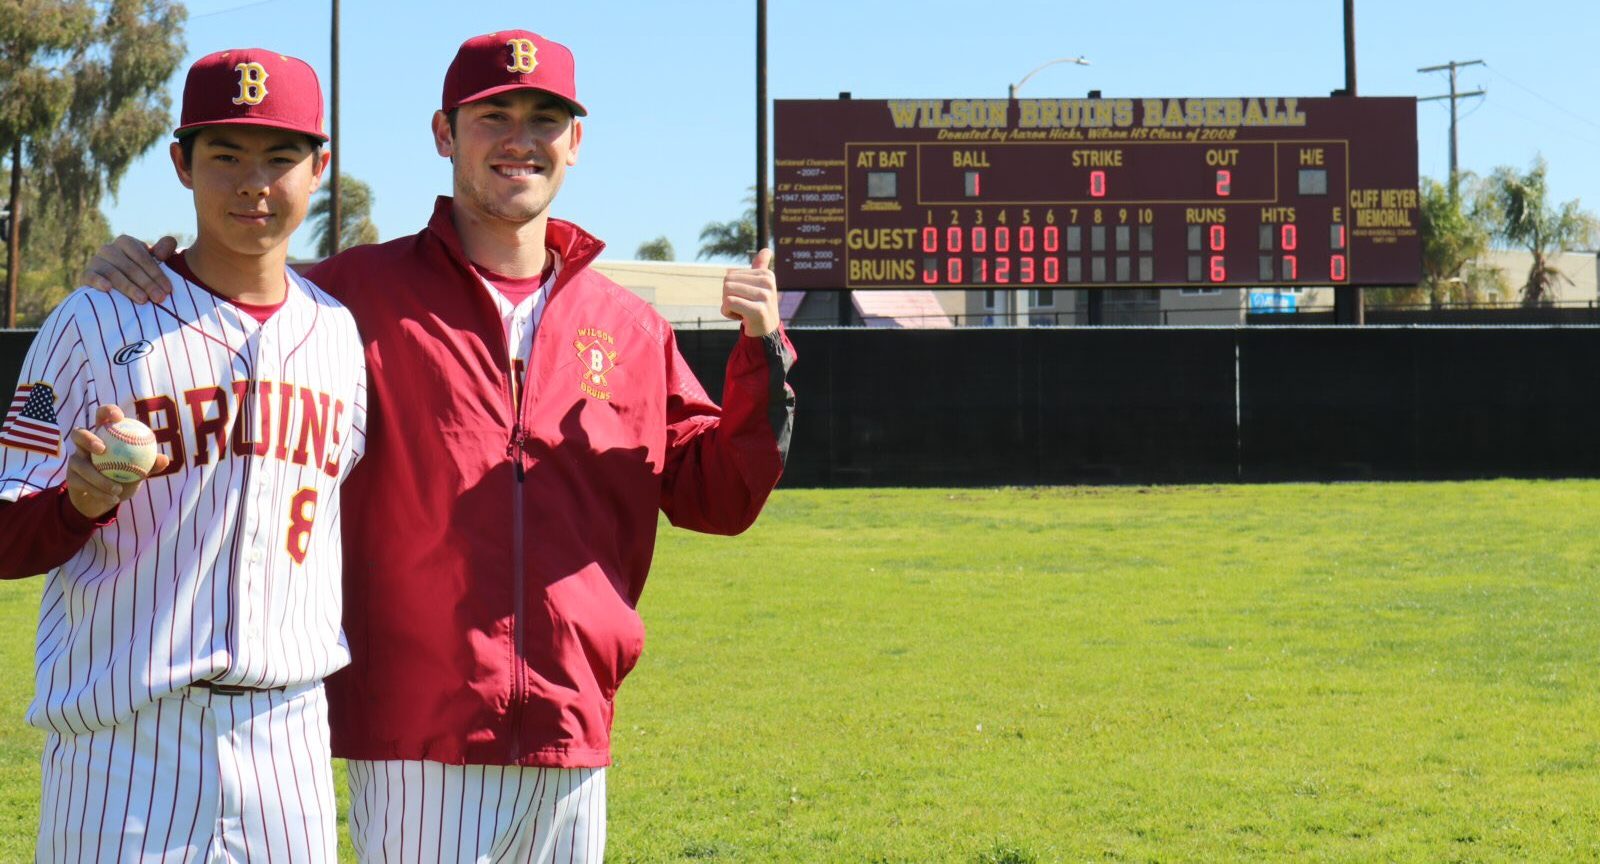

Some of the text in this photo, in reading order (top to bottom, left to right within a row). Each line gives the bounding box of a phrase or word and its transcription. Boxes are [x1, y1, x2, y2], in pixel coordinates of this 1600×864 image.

[506, 38, 539, 73] B
[232, 62, 269, 105] B
[887, 98, 1306, 128] WILSON BRUINS BASEBALL
[937, 128, 1237, 142] Donated by Aaron Hicks, Wilson HS Class of 2008
[857, 151, 907, 168] AT BAT
[952, 151, 990, 167] BALL
[1072, 150, 1123, 167] STRIKE
[1206, 149, 1239, 166] OUT
[1299, 149, 1324, 165] H/E
[973, 173, 980, 196] 1
[1090, 171, 1105, 197] 0
[1216, 170, 1230, 196] 2
[1350, 189, 1416, 208] CLIFF MEYER
[927, 208, 1153, 224] 1 2 3 4 5 6 7 8 9 10
[1186, 208, 1226, 223] RUNS
[1261, 207, 1296, 222] HITS
[1333, 207, 1341, 222] E
[1357, 209, 1411, 227] MEMORIAL
[847, 228, 918, 250] GUEST
[923, 224, 1344, 252] 0 0 0 0 0 0 0 0 1
[849, 259, 916, 281] BRUINS
[947, 258, 962, 283] 0
[980, 258, 987, 282] 1
[995, 257, 1010, 283] 2
[1020, 257, 1034, 283] 3
[1043, 257, 1059, 283] 0
[1210, 256, 1226, 282] 6
[1282, 255, 1296, 280] 7
[1330, 254, 1345, 281] 0
[577, 328, 615, 345] WILSON
[590, 349, 604, 372] B
[580, 381, 612, 400] BRUINS
[134, 379, 345, 479] BRUINS
[286, 486, 318, 567] 8
